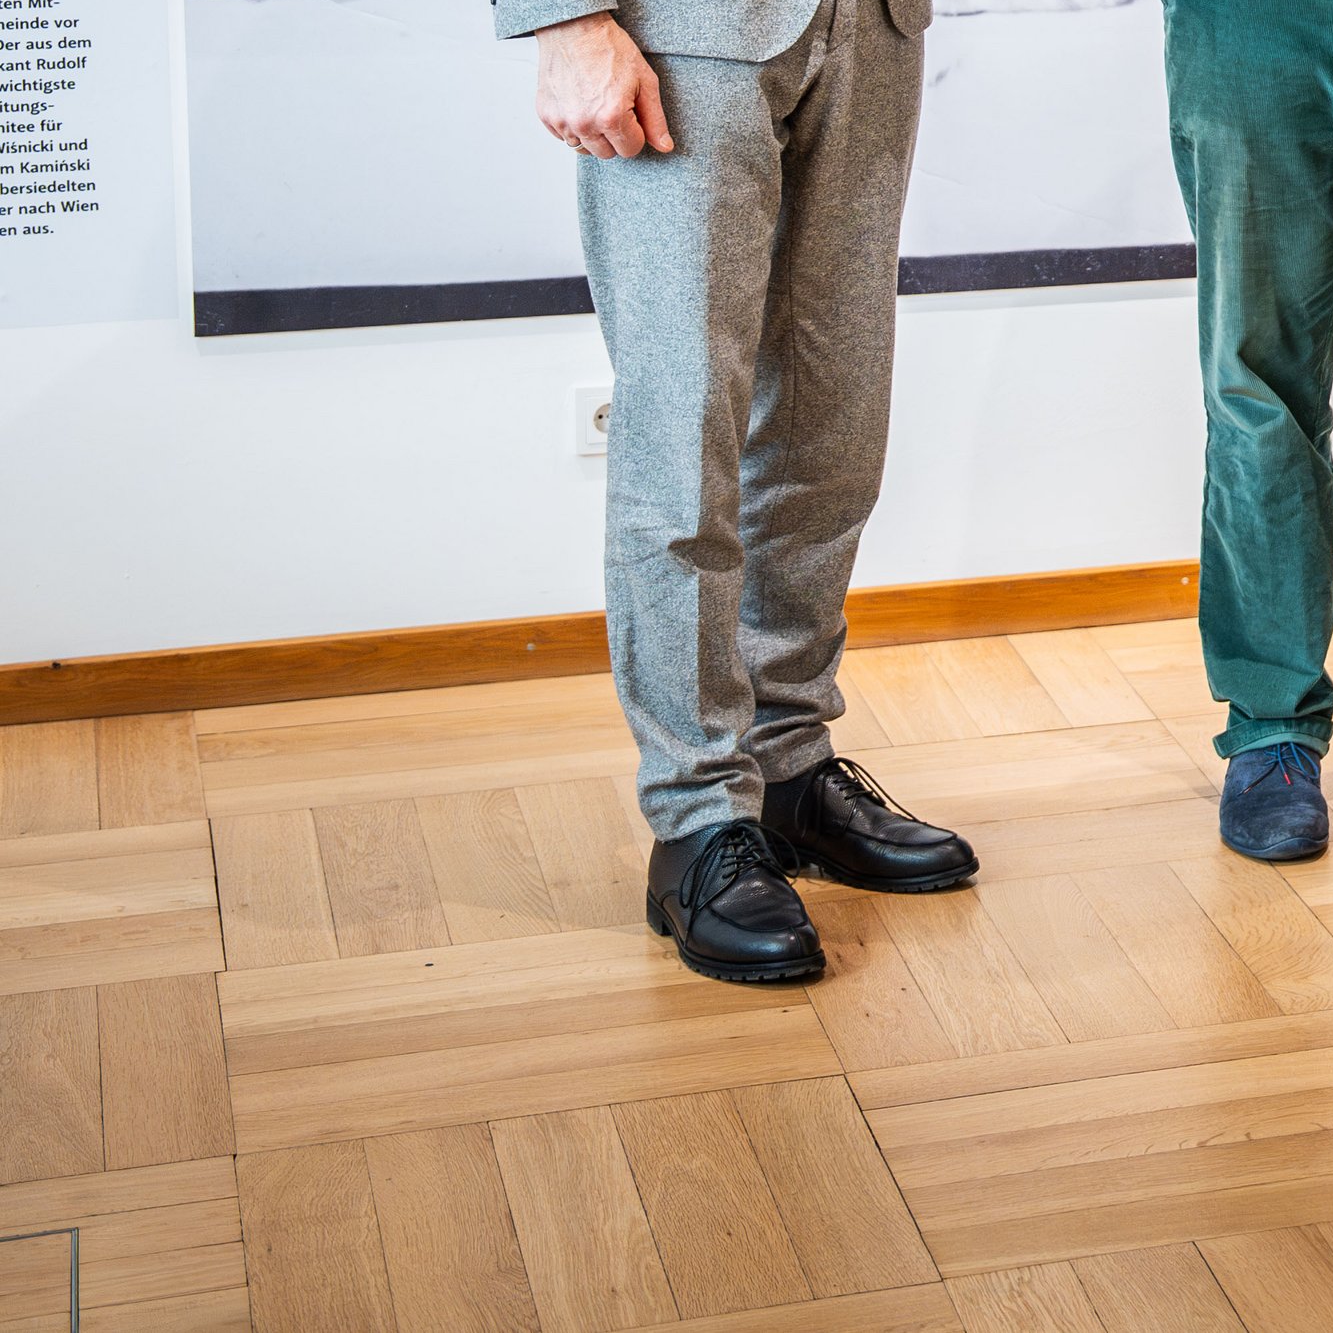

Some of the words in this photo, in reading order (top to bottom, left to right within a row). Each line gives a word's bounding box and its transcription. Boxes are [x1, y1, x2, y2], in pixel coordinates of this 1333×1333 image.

[53, 18, 80, 29] vor
[25, 40, 53, 51] aus
[57, 35, 92, 50] dem
[36, 55, 88, 71] Rudolf
[39, 118, 64, 133] für
[0, 139, 54, 155] iśnicki
[58, 137, 89, 152] und
[19, 158, 91, 174] Kamiński
[18, 200, 56, 216] nach
[60, 199, 100, 213] Wien
[22, 224, 55, 236] aus.
